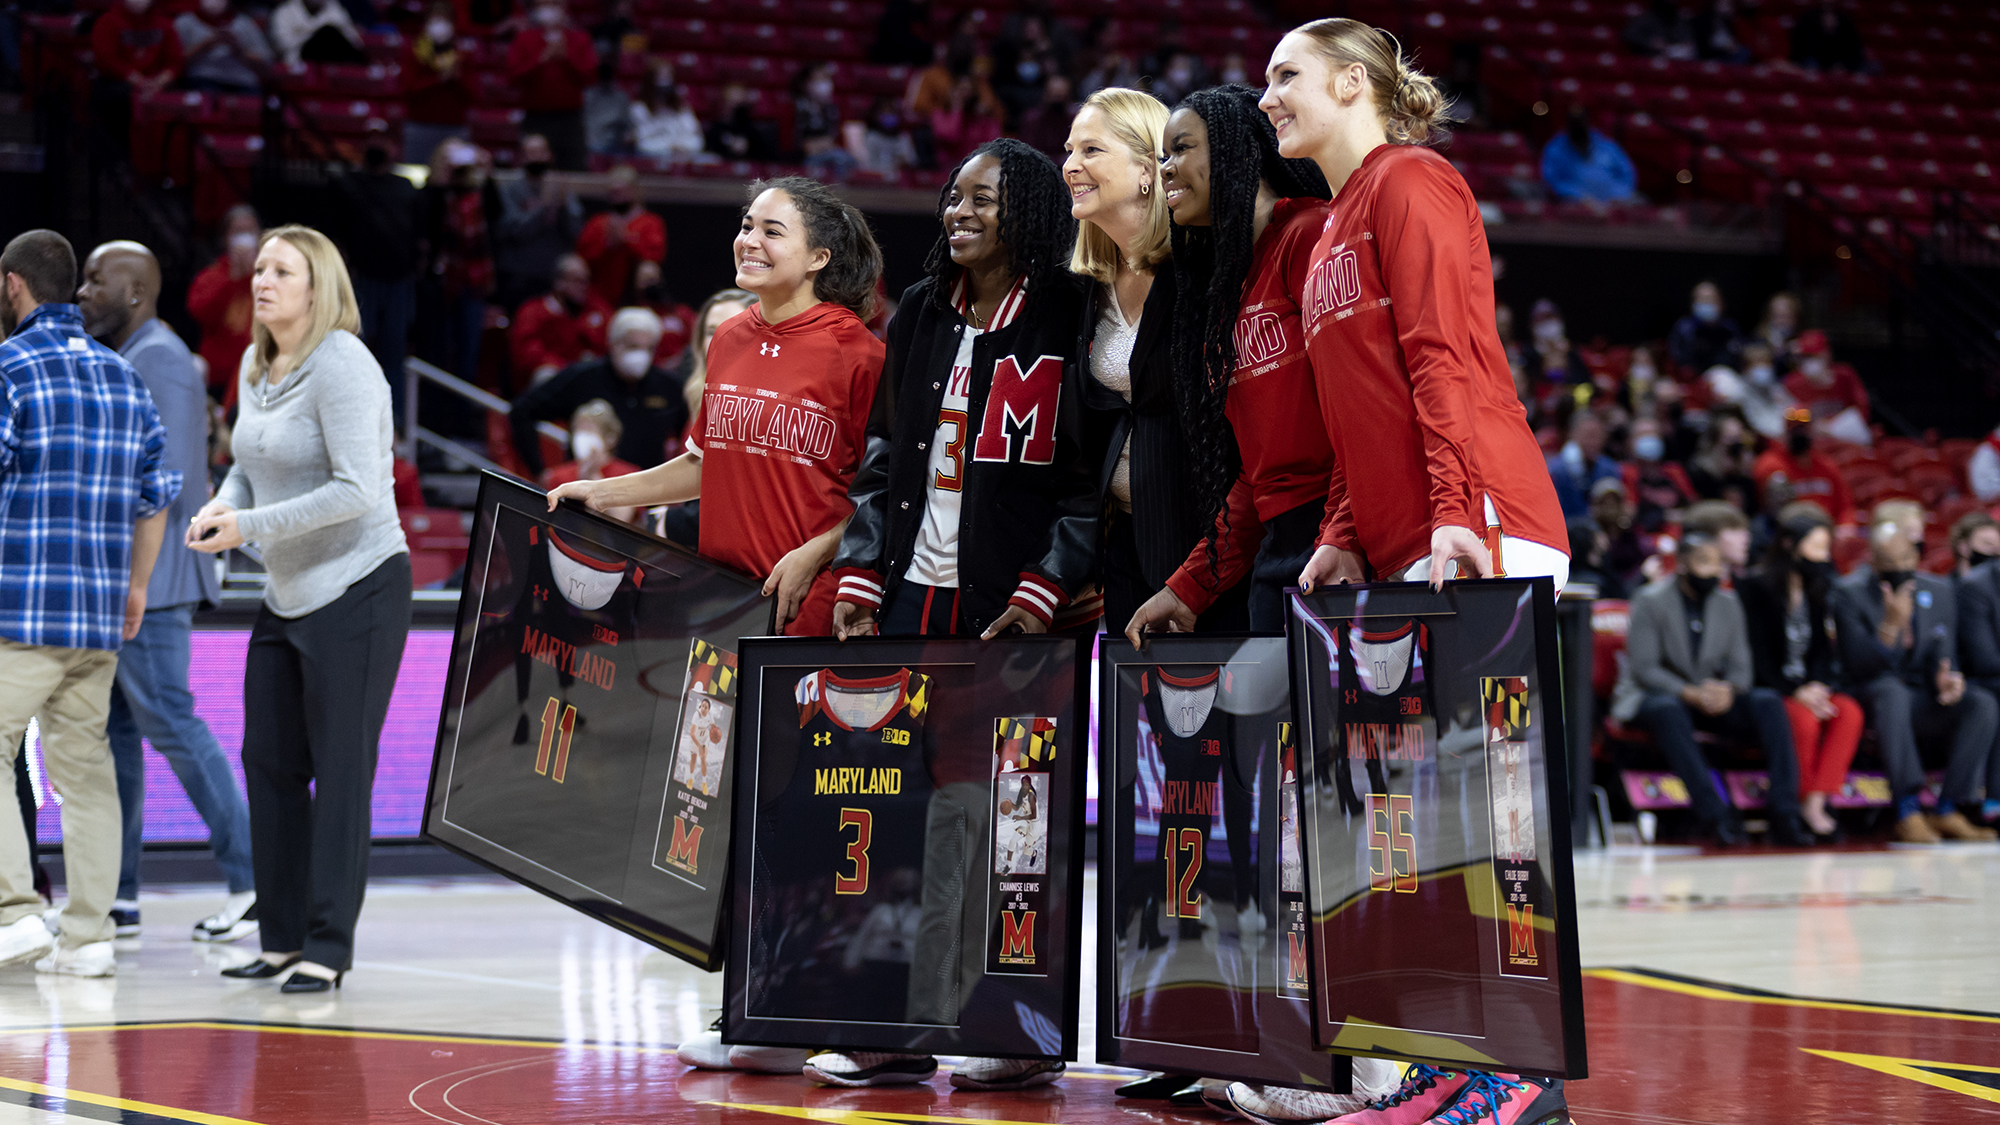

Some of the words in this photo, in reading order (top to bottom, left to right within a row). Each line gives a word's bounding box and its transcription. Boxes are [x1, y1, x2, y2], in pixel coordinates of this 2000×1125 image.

[1251, 360, 1280, 377] TERRAPINS
[755, 388, 779, 399] TERRAPINS
[800, 398, 828, 413] TERRAPINS
[973, 354, 1064, 465] M
[746, 445, 768, 457] TERRAPINS
[934, 408, 968, 492] 3
[520, 624, 617, 691] MARYLAND
[535, 696, 577, 784] 11
[1345, 722, 1425, 761] MARYLAND
[814, 767, 902, 796] MARYLAND
[1147, 780, 1221, 816] MARYLAND
[669, 815, 705, 867] M
[835, 807, 873, 895] 3
[1365, 793, 1418, 894] 55
[1000, 882, 1023, 892] CHANNISE
[1023, 883, 1039, 892] LEWIS
[1015, 892, 1022, 902] #3
[1164, 828, 1203, 920] 12
[999, 910, 1037, 957] M
[1506, 903, 1537, 957] M
